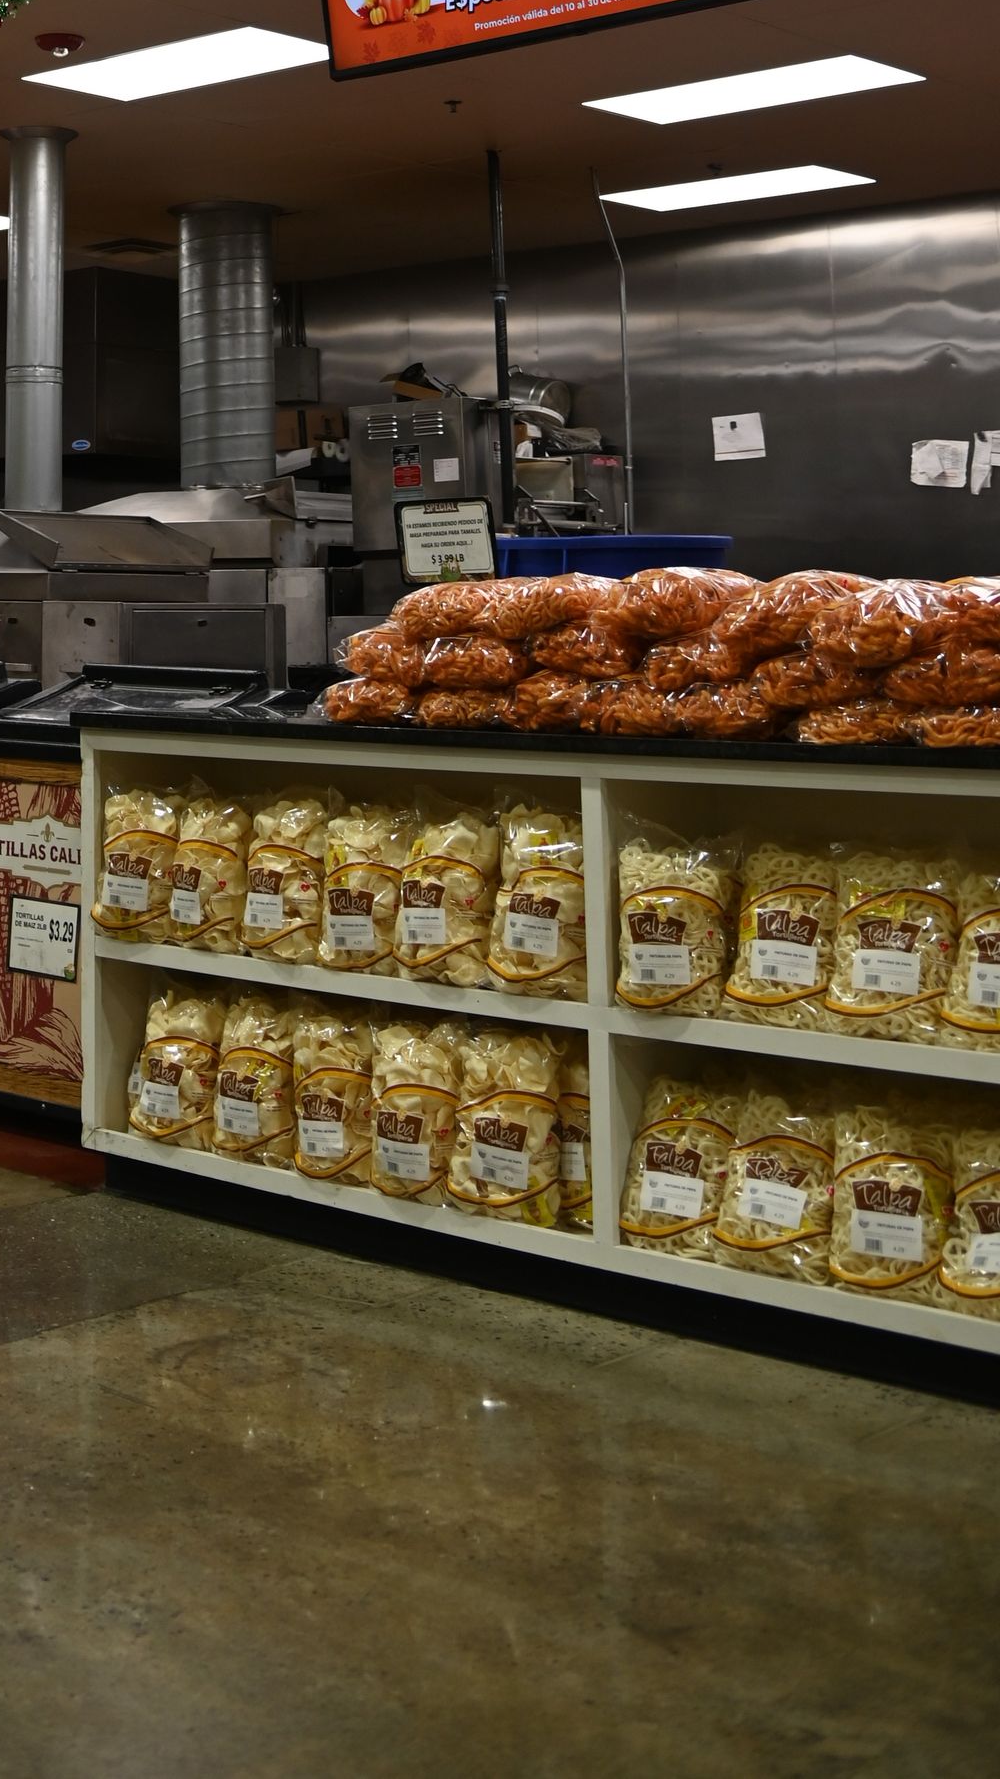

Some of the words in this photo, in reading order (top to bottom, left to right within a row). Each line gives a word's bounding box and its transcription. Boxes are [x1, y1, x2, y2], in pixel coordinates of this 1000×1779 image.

[474, 14, 520, 31] Promoción
[522, 8, 548, 21] válida
[550, 4, 564, 15] del
[566, 2, 575, 12] 10
[577, 0, 585, 10] al
[425, 502, 457, 512] SPECIAL
[455, 554, 464, 562] LB
[109, 855, 144, 876] Talpa
[330, 891, 368, 911] Talpa
[404, 882, 437, 903] Talpa
[513, 895, 551, 917] Talpa
[16, 912, 44, 921] TORTILLAS
[49, 919, 73, 943] $3.29
[630, 915, 677, 938] Talpa
[760, 913, 810, 938] Talpa
[863, 923, 912, 944] Talpa
[303, 1095, 338, 1117] Talpa
[380, 1115, 416, 1137] Talpa
[476, 1121, 520, 1145] Talpa
[650, 1145, 694, 1172] Talpa
[750, 1159, 797, 1183] Talpa
[857, 1183, 911, 1209] Talpa
